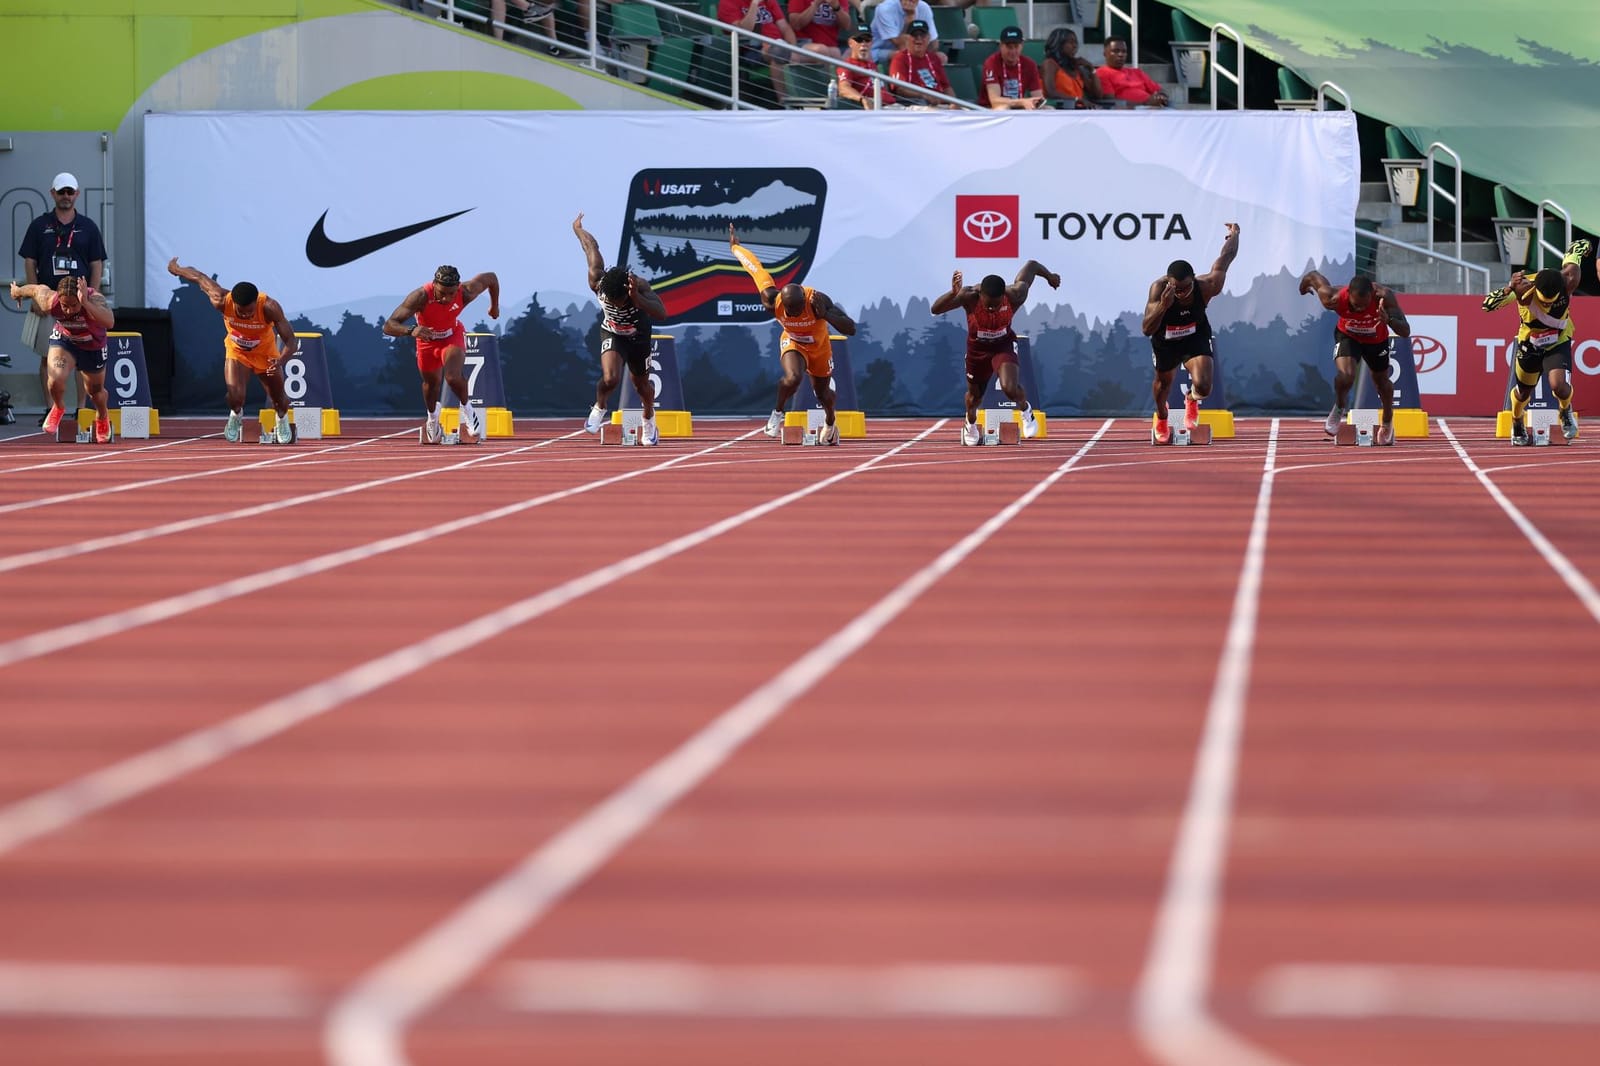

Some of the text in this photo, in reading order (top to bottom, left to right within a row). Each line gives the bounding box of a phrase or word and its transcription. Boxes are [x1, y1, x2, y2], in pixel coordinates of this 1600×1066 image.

[660, 184, 701, 195] USATF
[1034, 212, 1192, 241] TOYOTA
[113, 358, 138, 399] 9
[284, 358, 307, 399] 8
[464, 356, 485, 397] 7
